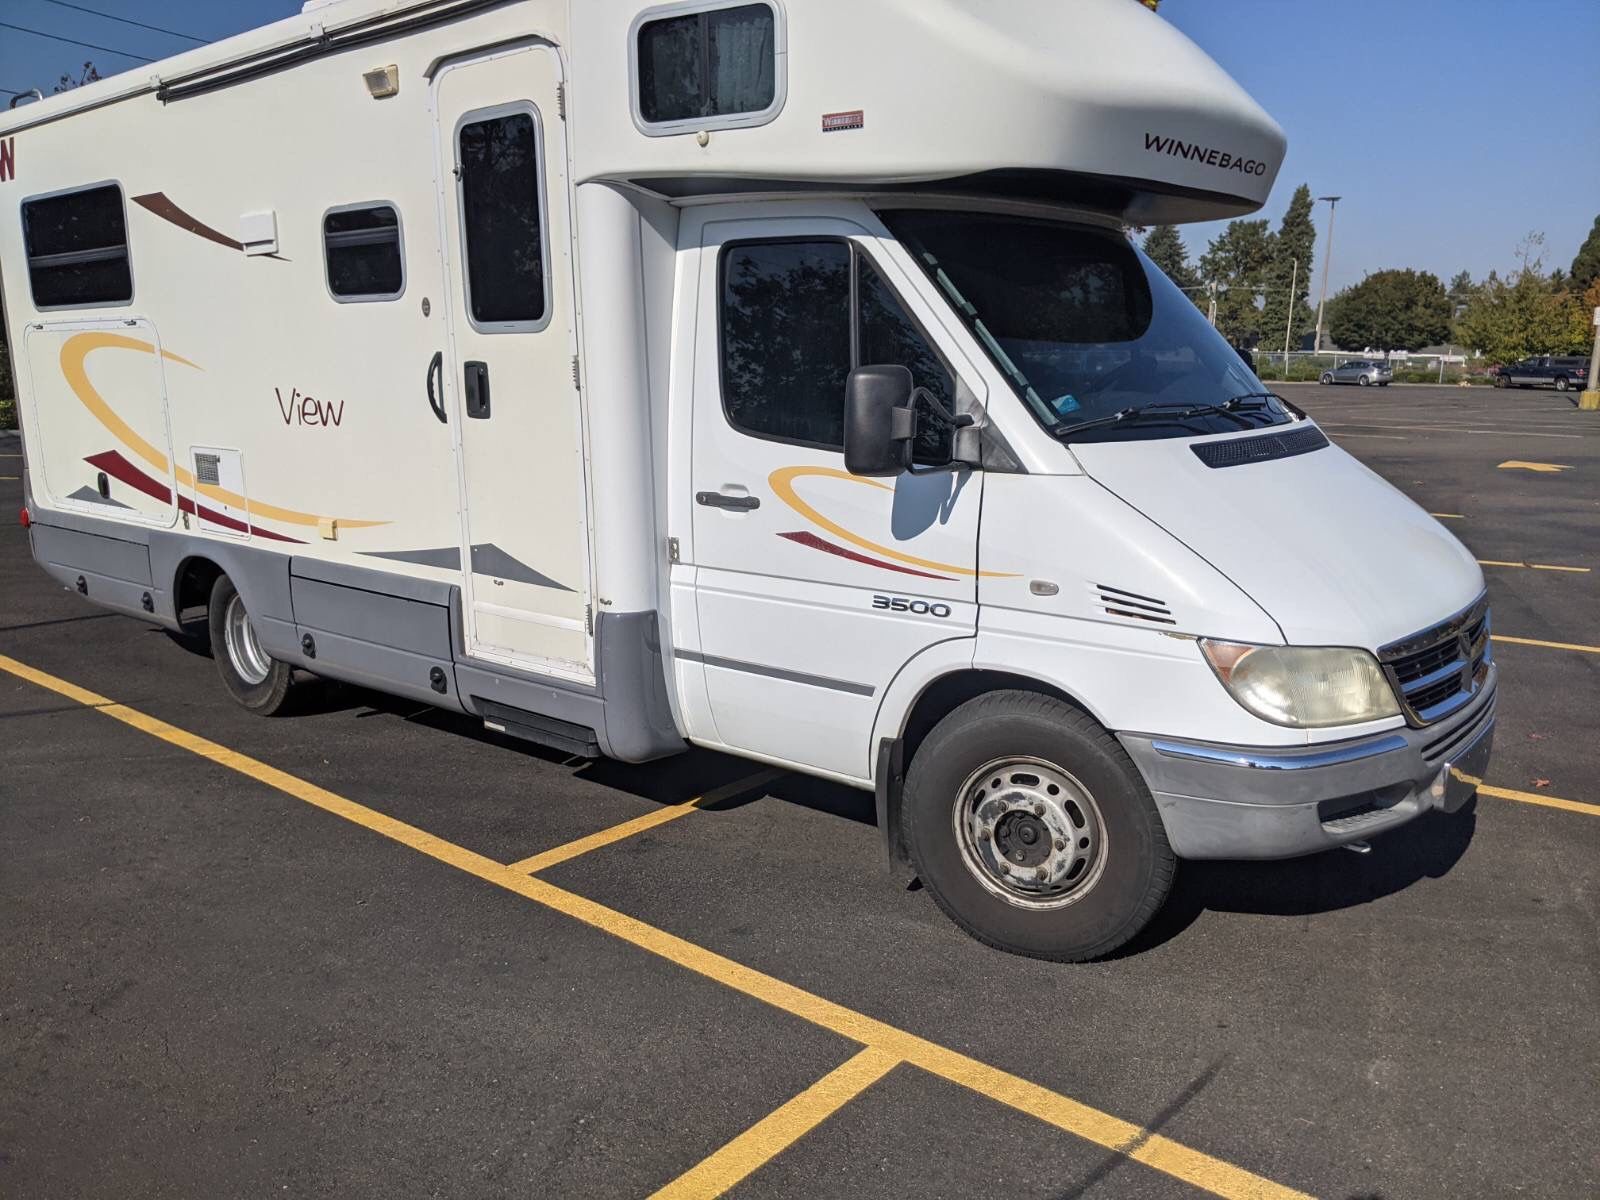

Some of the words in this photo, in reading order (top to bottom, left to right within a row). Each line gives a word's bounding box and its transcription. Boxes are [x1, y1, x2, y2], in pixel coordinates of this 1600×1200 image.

[1145, 133, 1266, 176] WINNEBAGO
[275, 387, 344, 426] View
[872, 595, 952, 617] 3500
